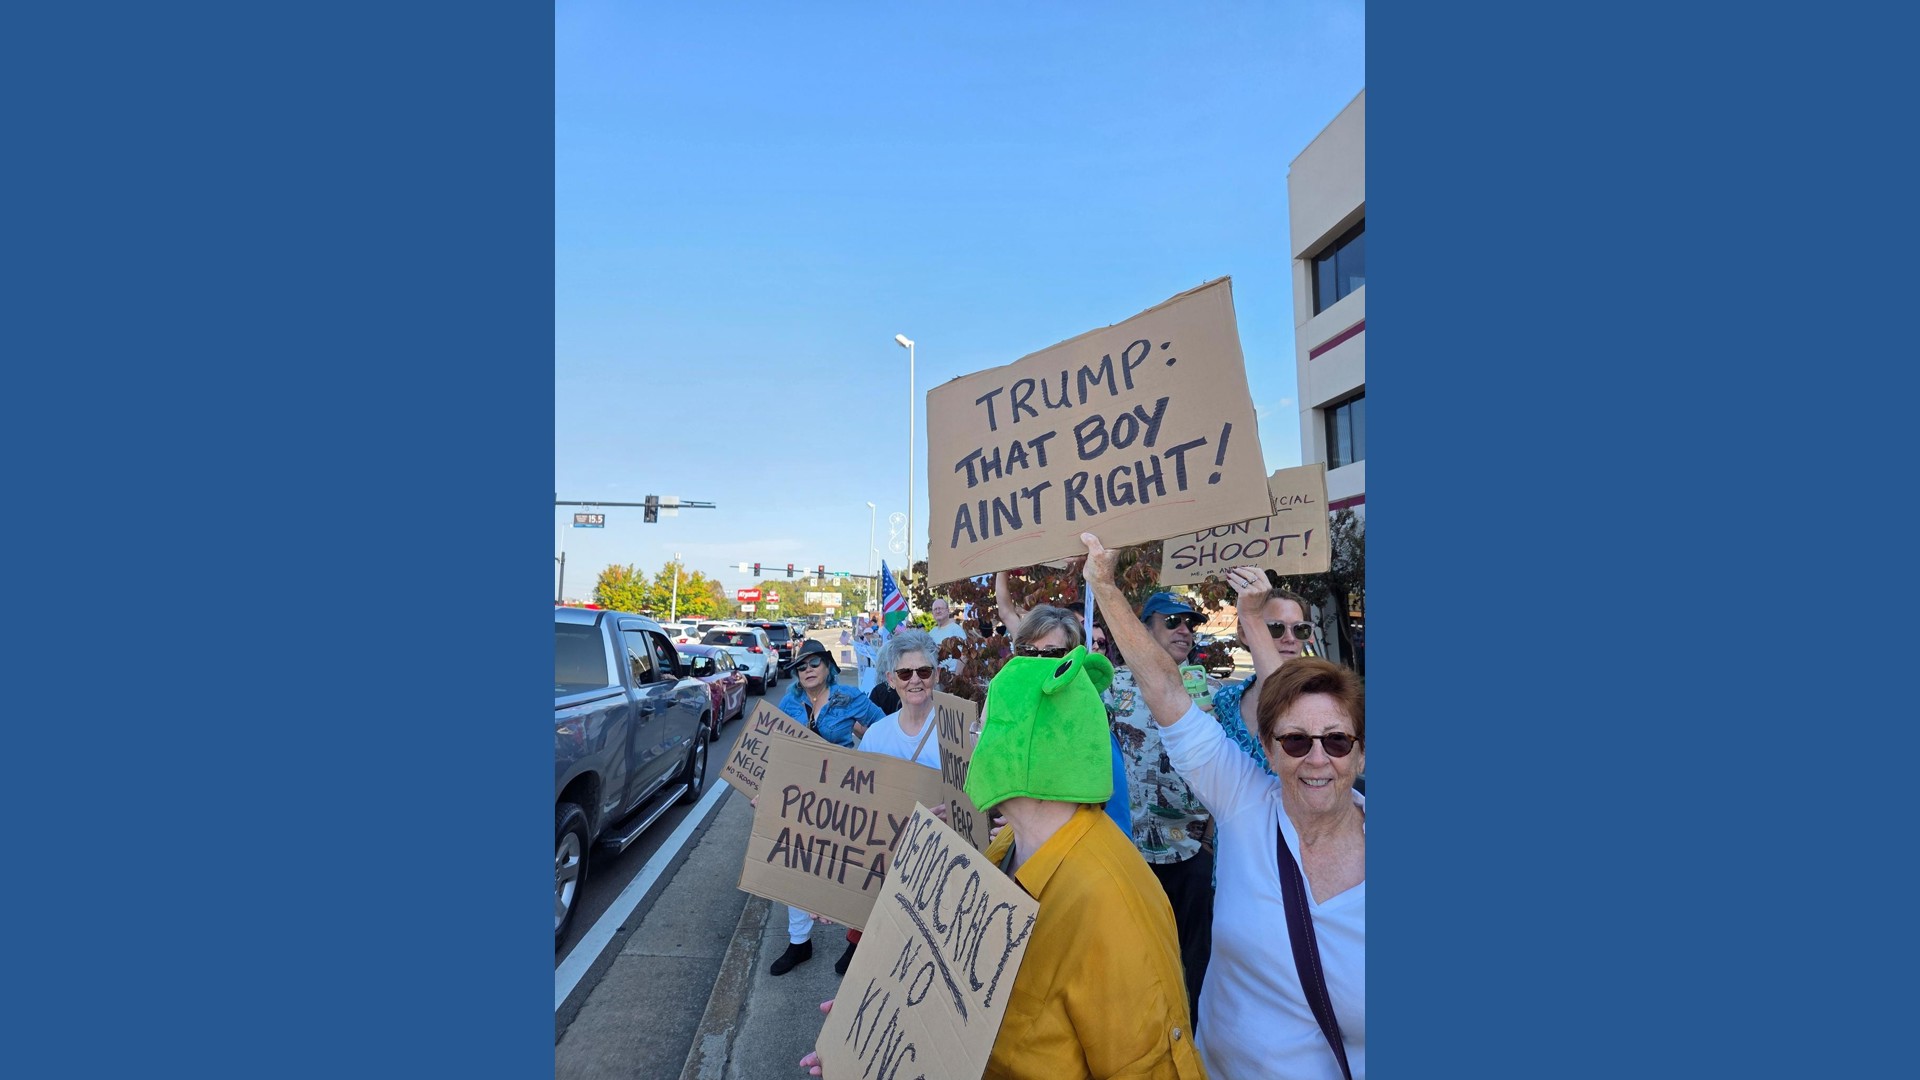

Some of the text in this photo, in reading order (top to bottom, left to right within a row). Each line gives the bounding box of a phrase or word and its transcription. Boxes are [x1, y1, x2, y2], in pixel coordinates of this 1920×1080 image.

[975, 338, 1177, 432] TRUMP:
[954, 396, 1170, 489] THAT BOY
[1064, 422, 1233, 522] RIGHT!
[1170, 529, 1314, 570] SHOOT!
[938, 704, 964, 749] ONLY
[735, 771, 759, 790] TROOPS
[819, 759, 875, 794] I AM
[781, 784, 910, 852] PROUDLY
[951, 800, 978, 850] FEAR
[766, 826, 886, 891] ANTIFA
[893, 809, 1036, 1008] DEMOCRACY
[889, 936, 935, 1008] NO
